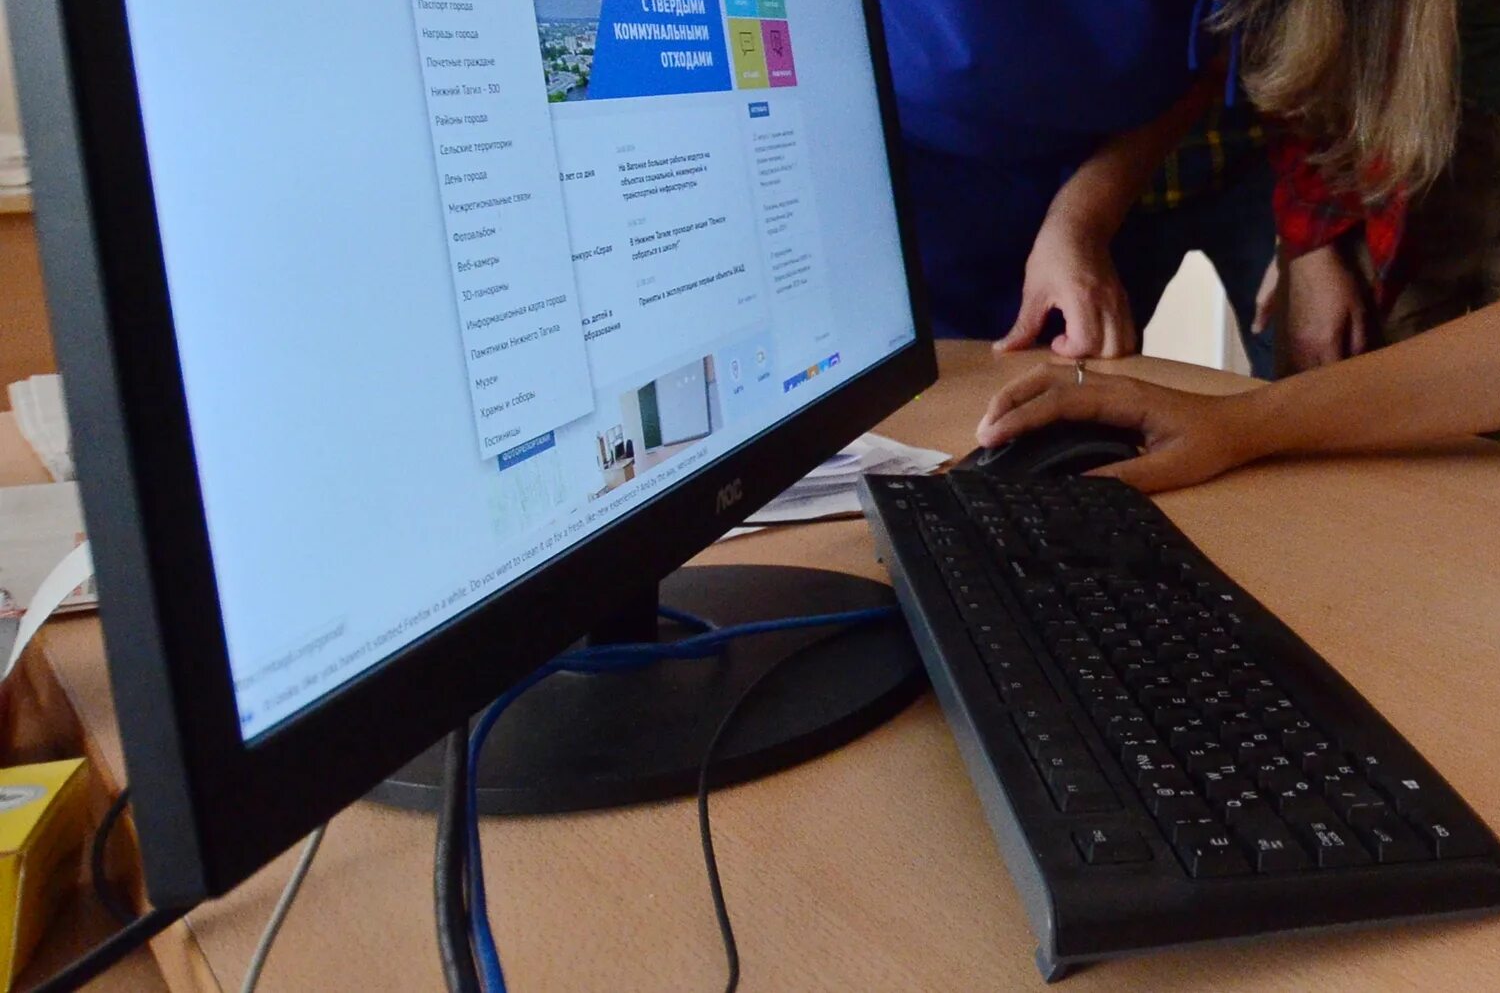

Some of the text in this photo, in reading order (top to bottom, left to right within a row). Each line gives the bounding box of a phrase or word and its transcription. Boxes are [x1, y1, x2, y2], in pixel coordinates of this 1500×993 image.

[418, 0, 473, 11] Паспорт города
[422, 29, 479, 40] Награды города
[614, 22, 709, 41] КОММУНАЛЬНЫМИ
[426, 57, 495, 68] Почетные граждане
[661, 51, 713, 70] ОТХОДАМИ
[431, 85, 460, 97] Нижний
[461, 85, 482, 95] Тагил
[488, 83, 500, 94] 500
[435, 113, 488, 126] Районы города
[440, 140, 512, 155] Сельские территории
[444, 171, 487, 186] День города
[565, 169, 595, 181] лет со дня
[448, 192, 532, 214] Межрегиональные связи
[453, 227, 496, 242] Фотоальбом
[457, 256, 500, 273] Веб-камеры
[462, 282, 509, 301] 3D-панорамы
[466, 294, 567, 331] Информационная карта города
[591, 310, 608, 323] детей
[471, 323, 560, 360] Памятники Нижнего Тагила
[475, 375, 498, 390] Музеи
[480, 403, 505, 419] Храмы
[511, 391, 536, 407] соборы
[484, 425, 521, 447] Гостиницы
